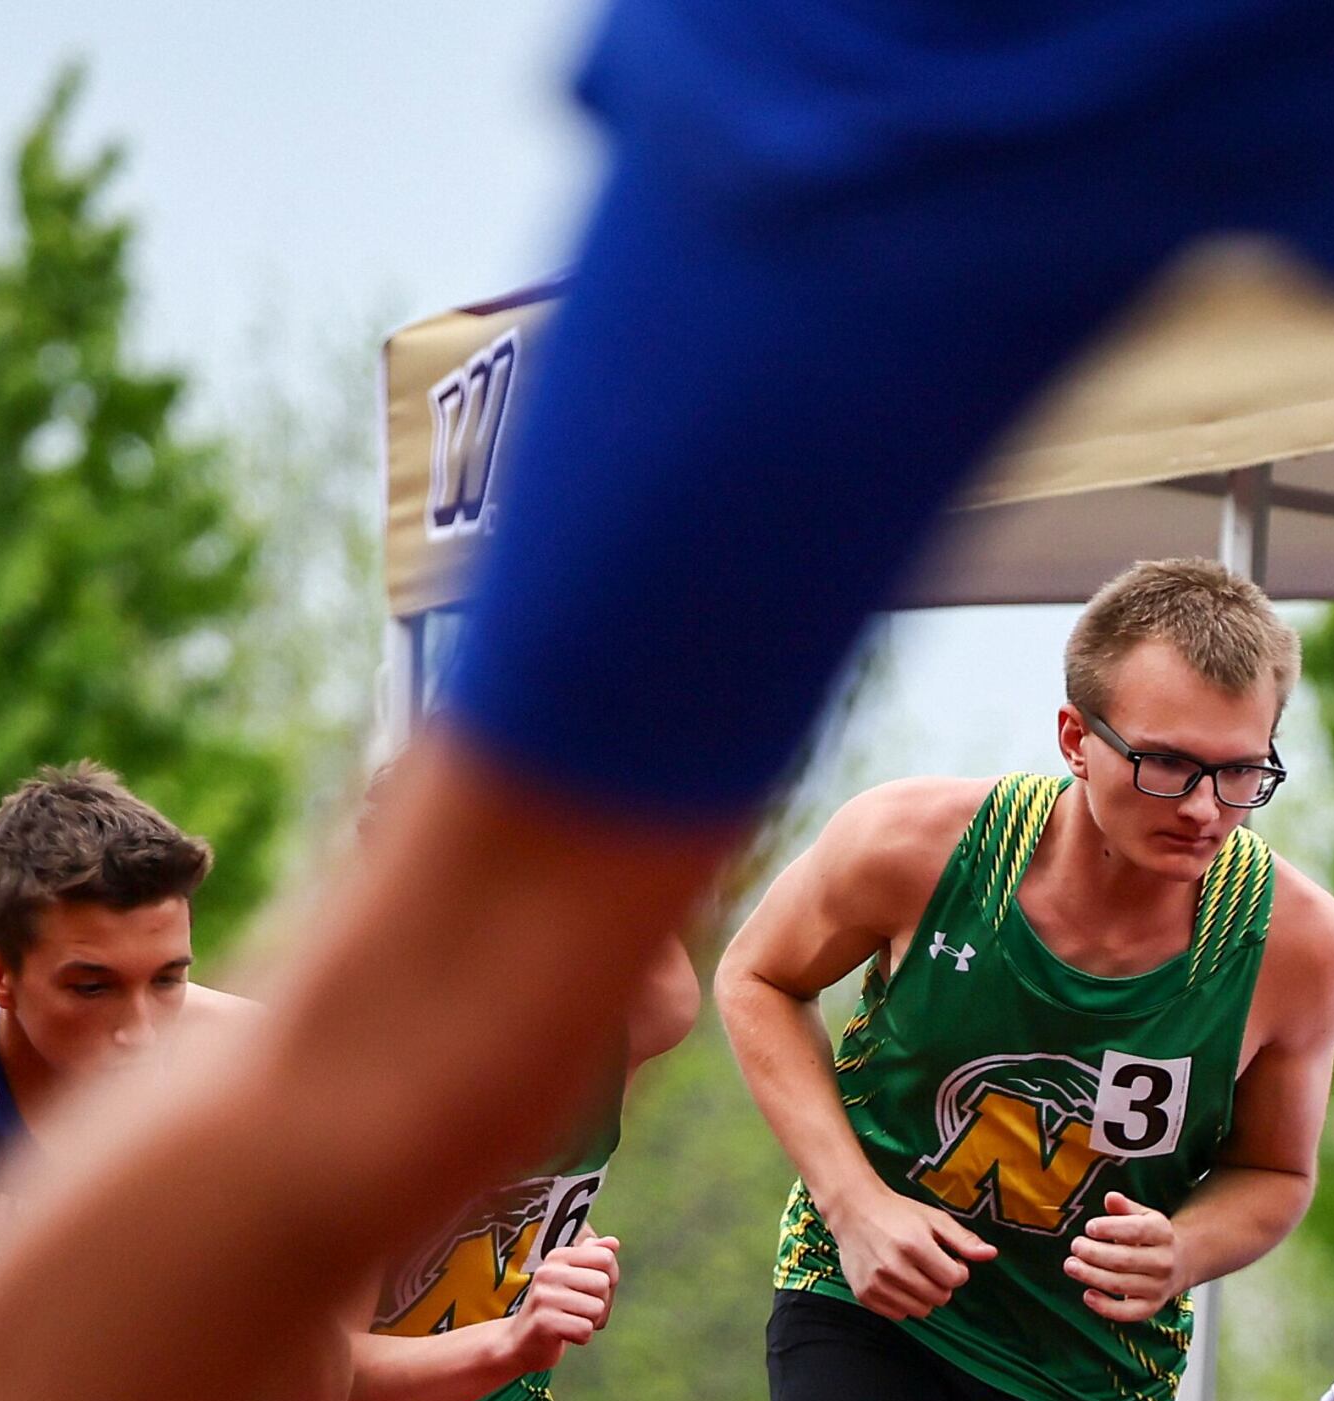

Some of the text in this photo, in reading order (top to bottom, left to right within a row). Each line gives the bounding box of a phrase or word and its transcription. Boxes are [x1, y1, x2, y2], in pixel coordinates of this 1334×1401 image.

[427, 326, 518, 543] W
[1103, 1063, 1173, 1151] 3
[540, 1176, 601, 1261] 6
